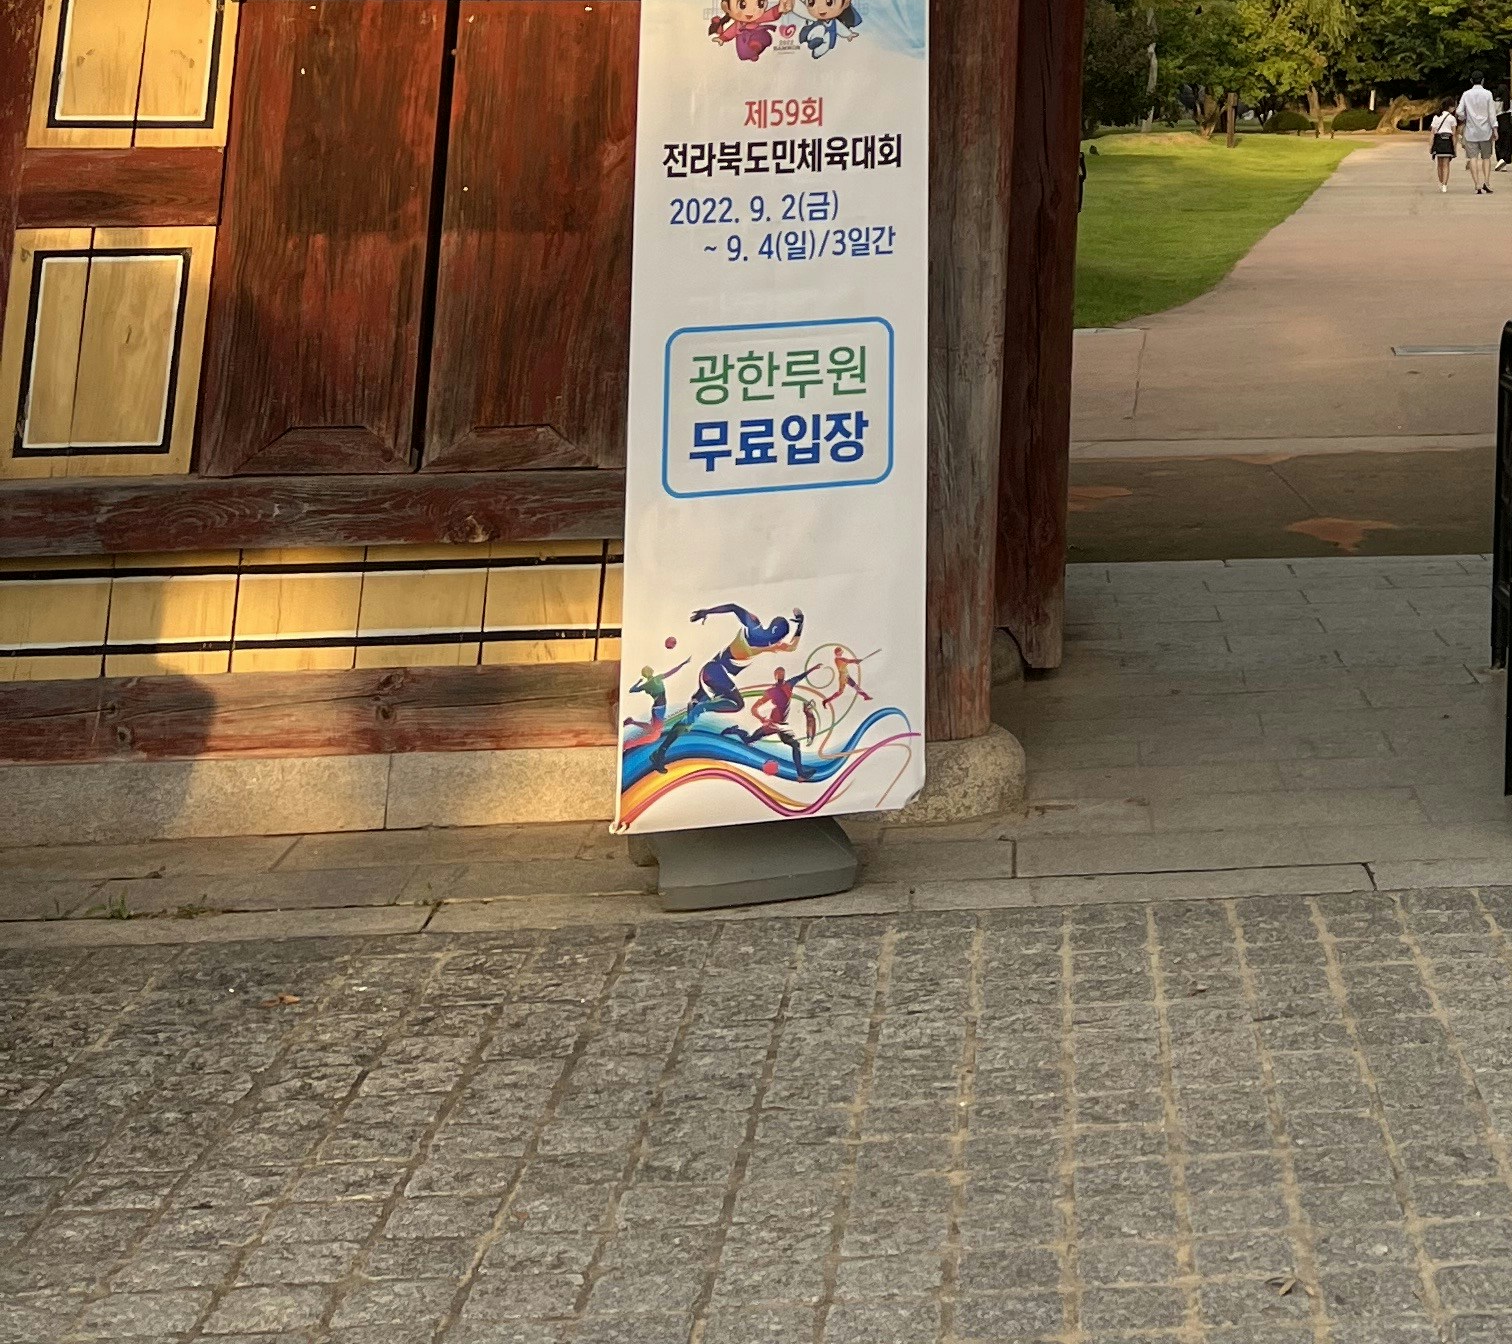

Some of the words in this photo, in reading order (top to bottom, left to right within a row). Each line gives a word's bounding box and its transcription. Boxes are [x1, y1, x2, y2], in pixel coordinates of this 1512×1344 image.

[743, 96, 824, 129] 제59회
[662, 133, 903, 179] 전라북도민체육대회
[689, 345, 867, 405] 광한루원
[689, 410, 870, 473] 무료입장
